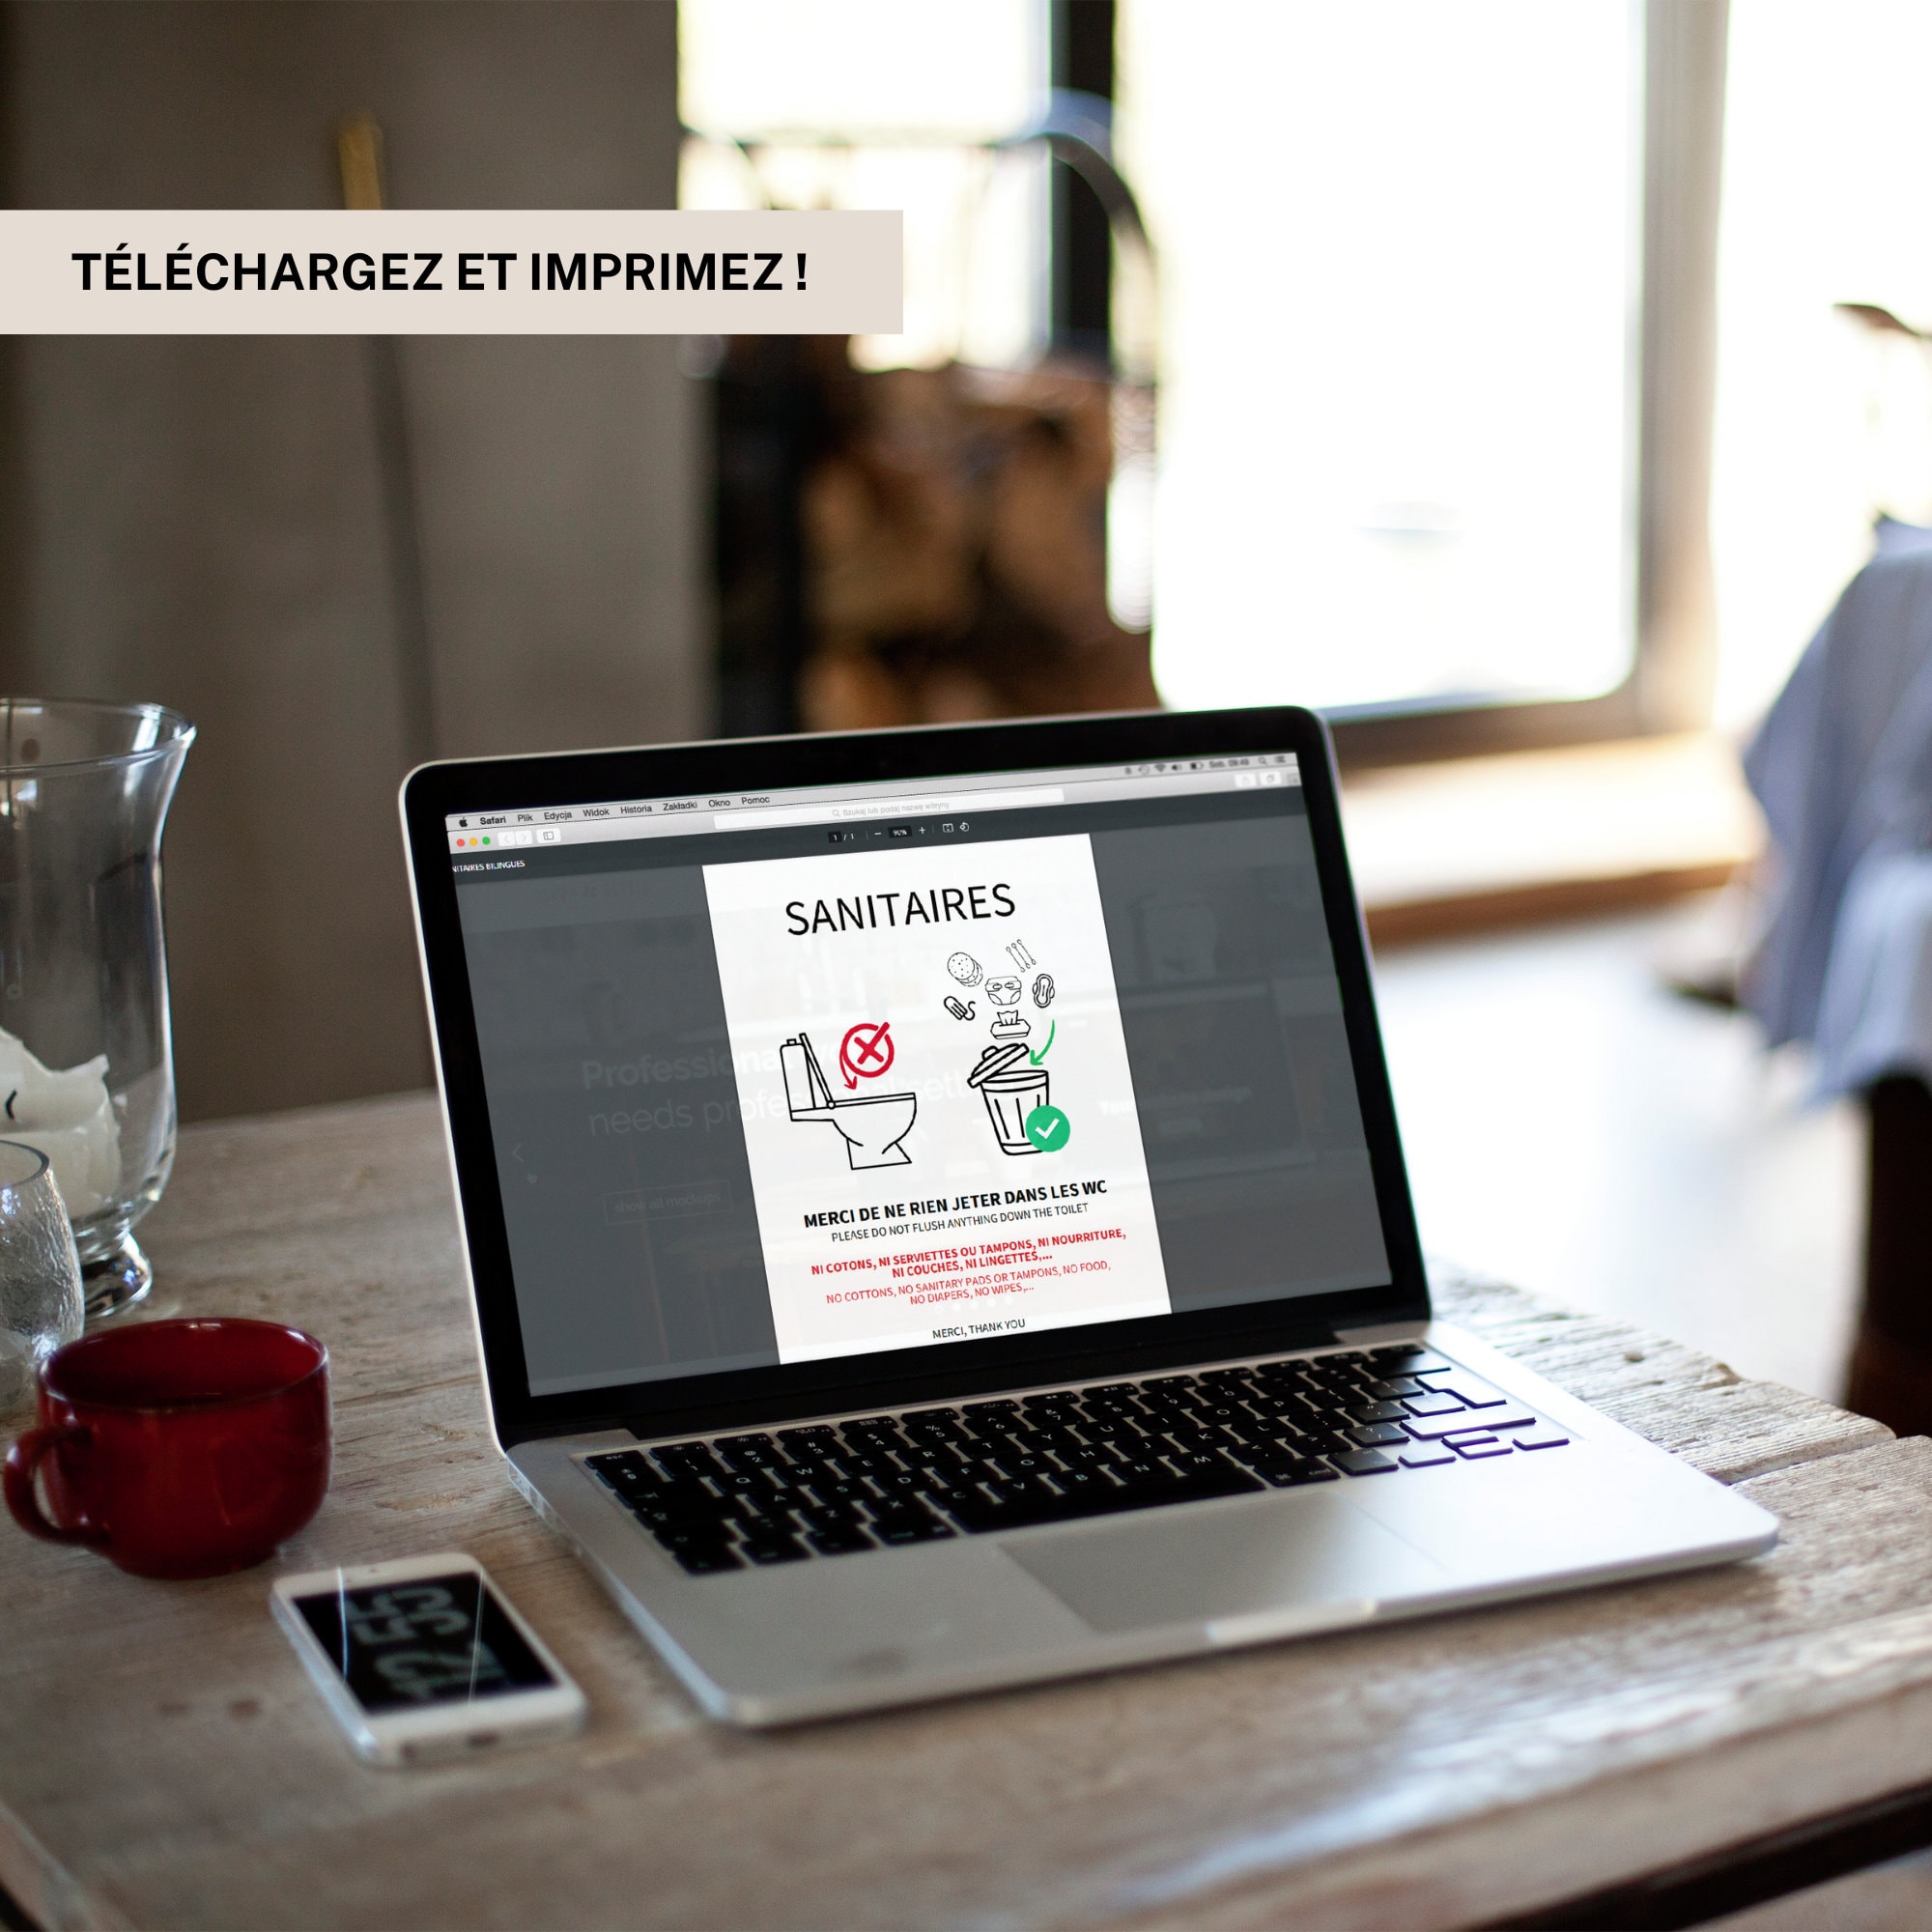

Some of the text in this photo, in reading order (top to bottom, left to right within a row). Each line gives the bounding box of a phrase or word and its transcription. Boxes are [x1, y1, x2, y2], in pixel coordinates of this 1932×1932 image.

[480, 796, 770, 825] Safari Plik Edycja Widok Historia Zakładki Okno Pomoc
[785, 882, 1015, 935] SANITAIRES
[803, 1179, 1107, 1228] MERCI DE NE RIEN JETER DANS LES WC
[831, 1202, 1088, 1241] PLEASE DO NOT FLUSH ANYTHING DOWN THE TOILET
[810, 1228, 1125, 1275] NI COTONS, NI SERVIETTES OU TAMPONS, NI NOURRITURE,
[892, 1266, 904, 1278] NI
[906, 1260, 963, 1276] COUCHES,
[964, 1258, 977, 1268] NI
[826, 1293, 841, 1303] NO
[898, 1284, 914, 1294] NO
[916, 1277, 964, 1293] SANITARY
[965, 1273, 992, 1287] PADS
[994, 1271, 1009, 1283] OR
[1063, 1264, 1079, 1274] NO
[909, 1293, 925, 1304] NO
[974, 1286, 989, 1296] NO
[931, 1318, 1025, 1339] MERCI, THANK YOU
